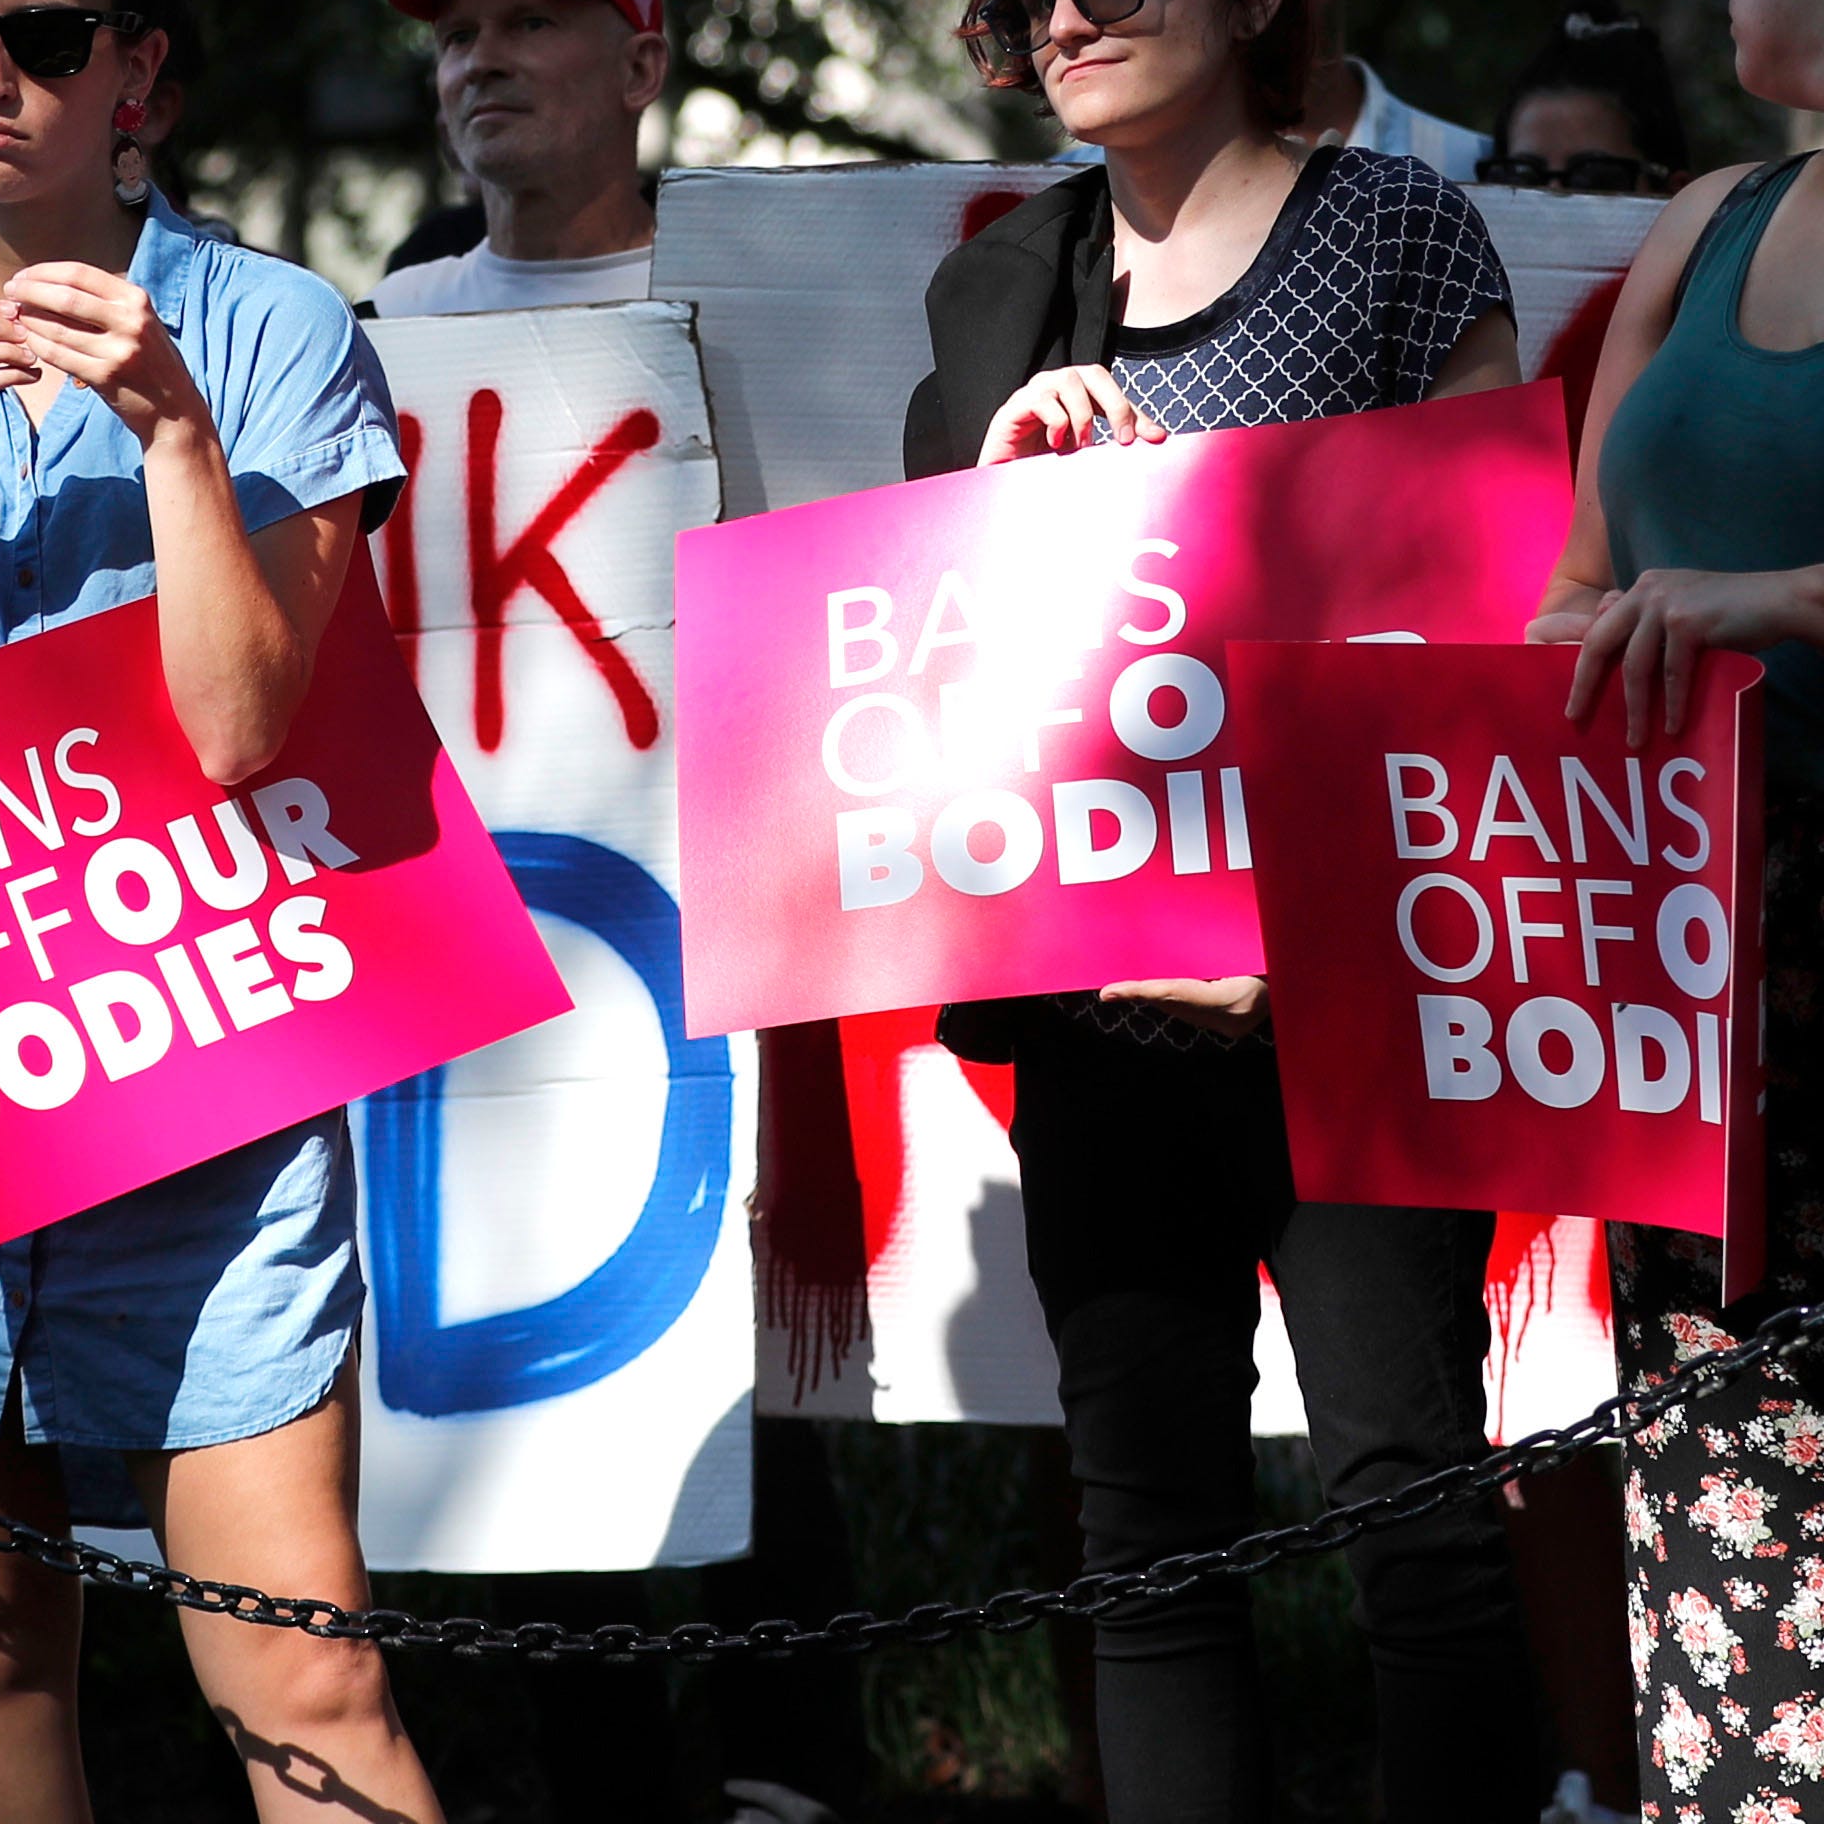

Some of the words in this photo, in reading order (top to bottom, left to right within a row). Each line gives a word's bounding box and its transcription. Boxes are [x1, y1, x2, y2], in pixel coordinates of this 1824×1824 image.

[826, 537, 1188, 689] BAS
[83, 777, 361, 946] OUR
[835, 766, 1254, 912] BODI
[1384, 752, 1711, 873] BANS
[1396, 872, 1635, 987] OFF
[1416, 993, 1727, 1125] BODI
